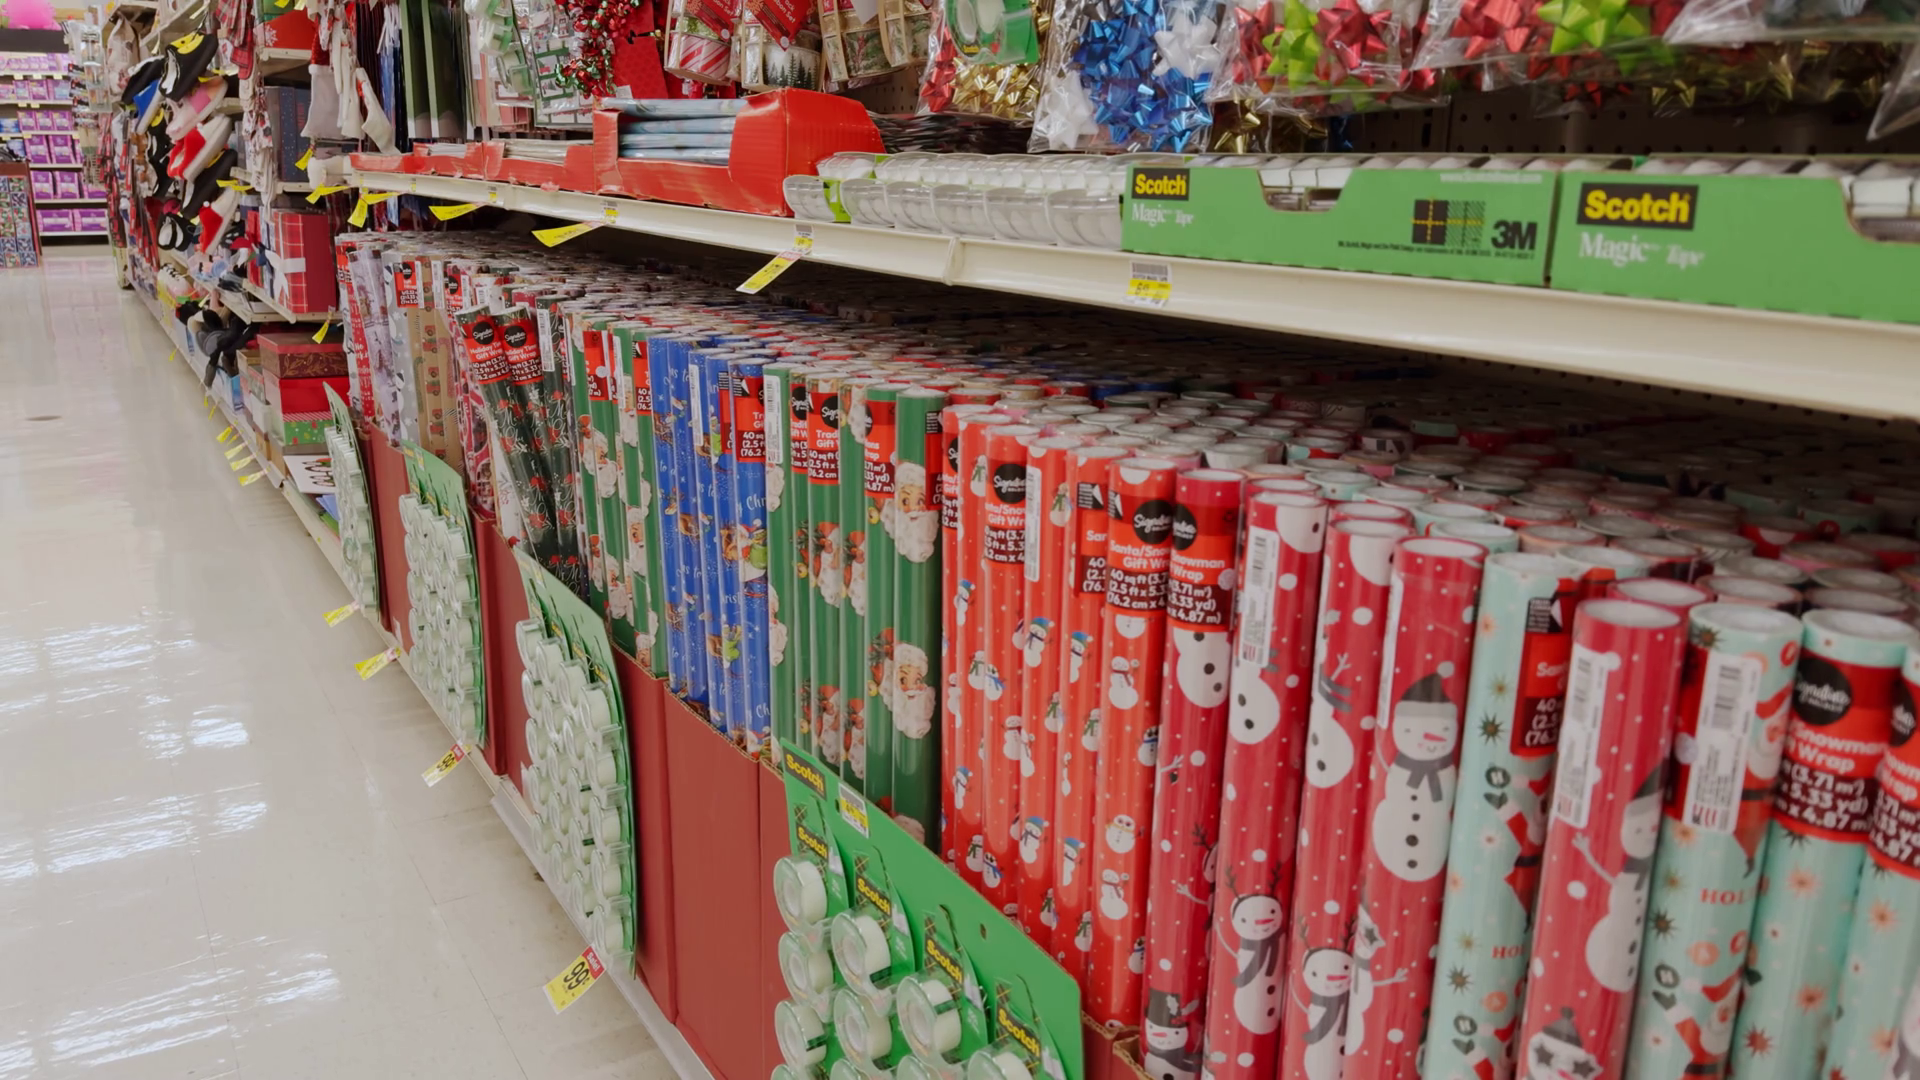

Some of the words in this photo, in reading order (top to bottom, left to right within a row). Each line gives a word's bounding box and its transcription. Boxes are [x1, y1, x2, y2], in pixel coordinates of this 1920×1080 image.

[1135, 173, 1187, 195] Scotch
[1132, 203, 1168, 228] Magic
[1584, 188, 1690, 223] Scotch
[1491, 220, 1538, 250] 3M
[1579, 232, 1649, 267] Magic
[743, 431, 755, 439] 40
[743, 440, 759, 449] (2.5
[816, 439, 834, 448] Gift
[741, 448, 761, 457] (76.2
[1089, 557, 1106, 569] 40
[1123, 556, 1148, 569] Gift
[1110, 567, 1125, 581] 40
[1137, 574, 1147, 585] ft
[1129, 585, 1139, 597] ft
[1140, 589, 1147, 597] x
[1132, 600, 1148, 609] cm
[1150, 600, 1157, 609] x
[1178, 609, 1205, 623] 4.87
[1206, 611, 1221, 625] m)
[1195, 598, 1217, 612] yd)
[1799, 742, 1855, 774] Wrap
[786, 754, 824, 796] Scotch
[1792, 763, 1835, 790] (3.71
[1791, 783, 1834, 809] 5.33
[1837, 796, 1869, 816] yd)
[1788, 803, 1800, 818] x
[1802, 806, 1850, 830] 4.87
[798, 827, 828, 859] Scotch
[858, 878, 890, 915] Scotch
[926, 939, 962, 984] Scotch
[998, 1008, 1040, 1057] Scotch
